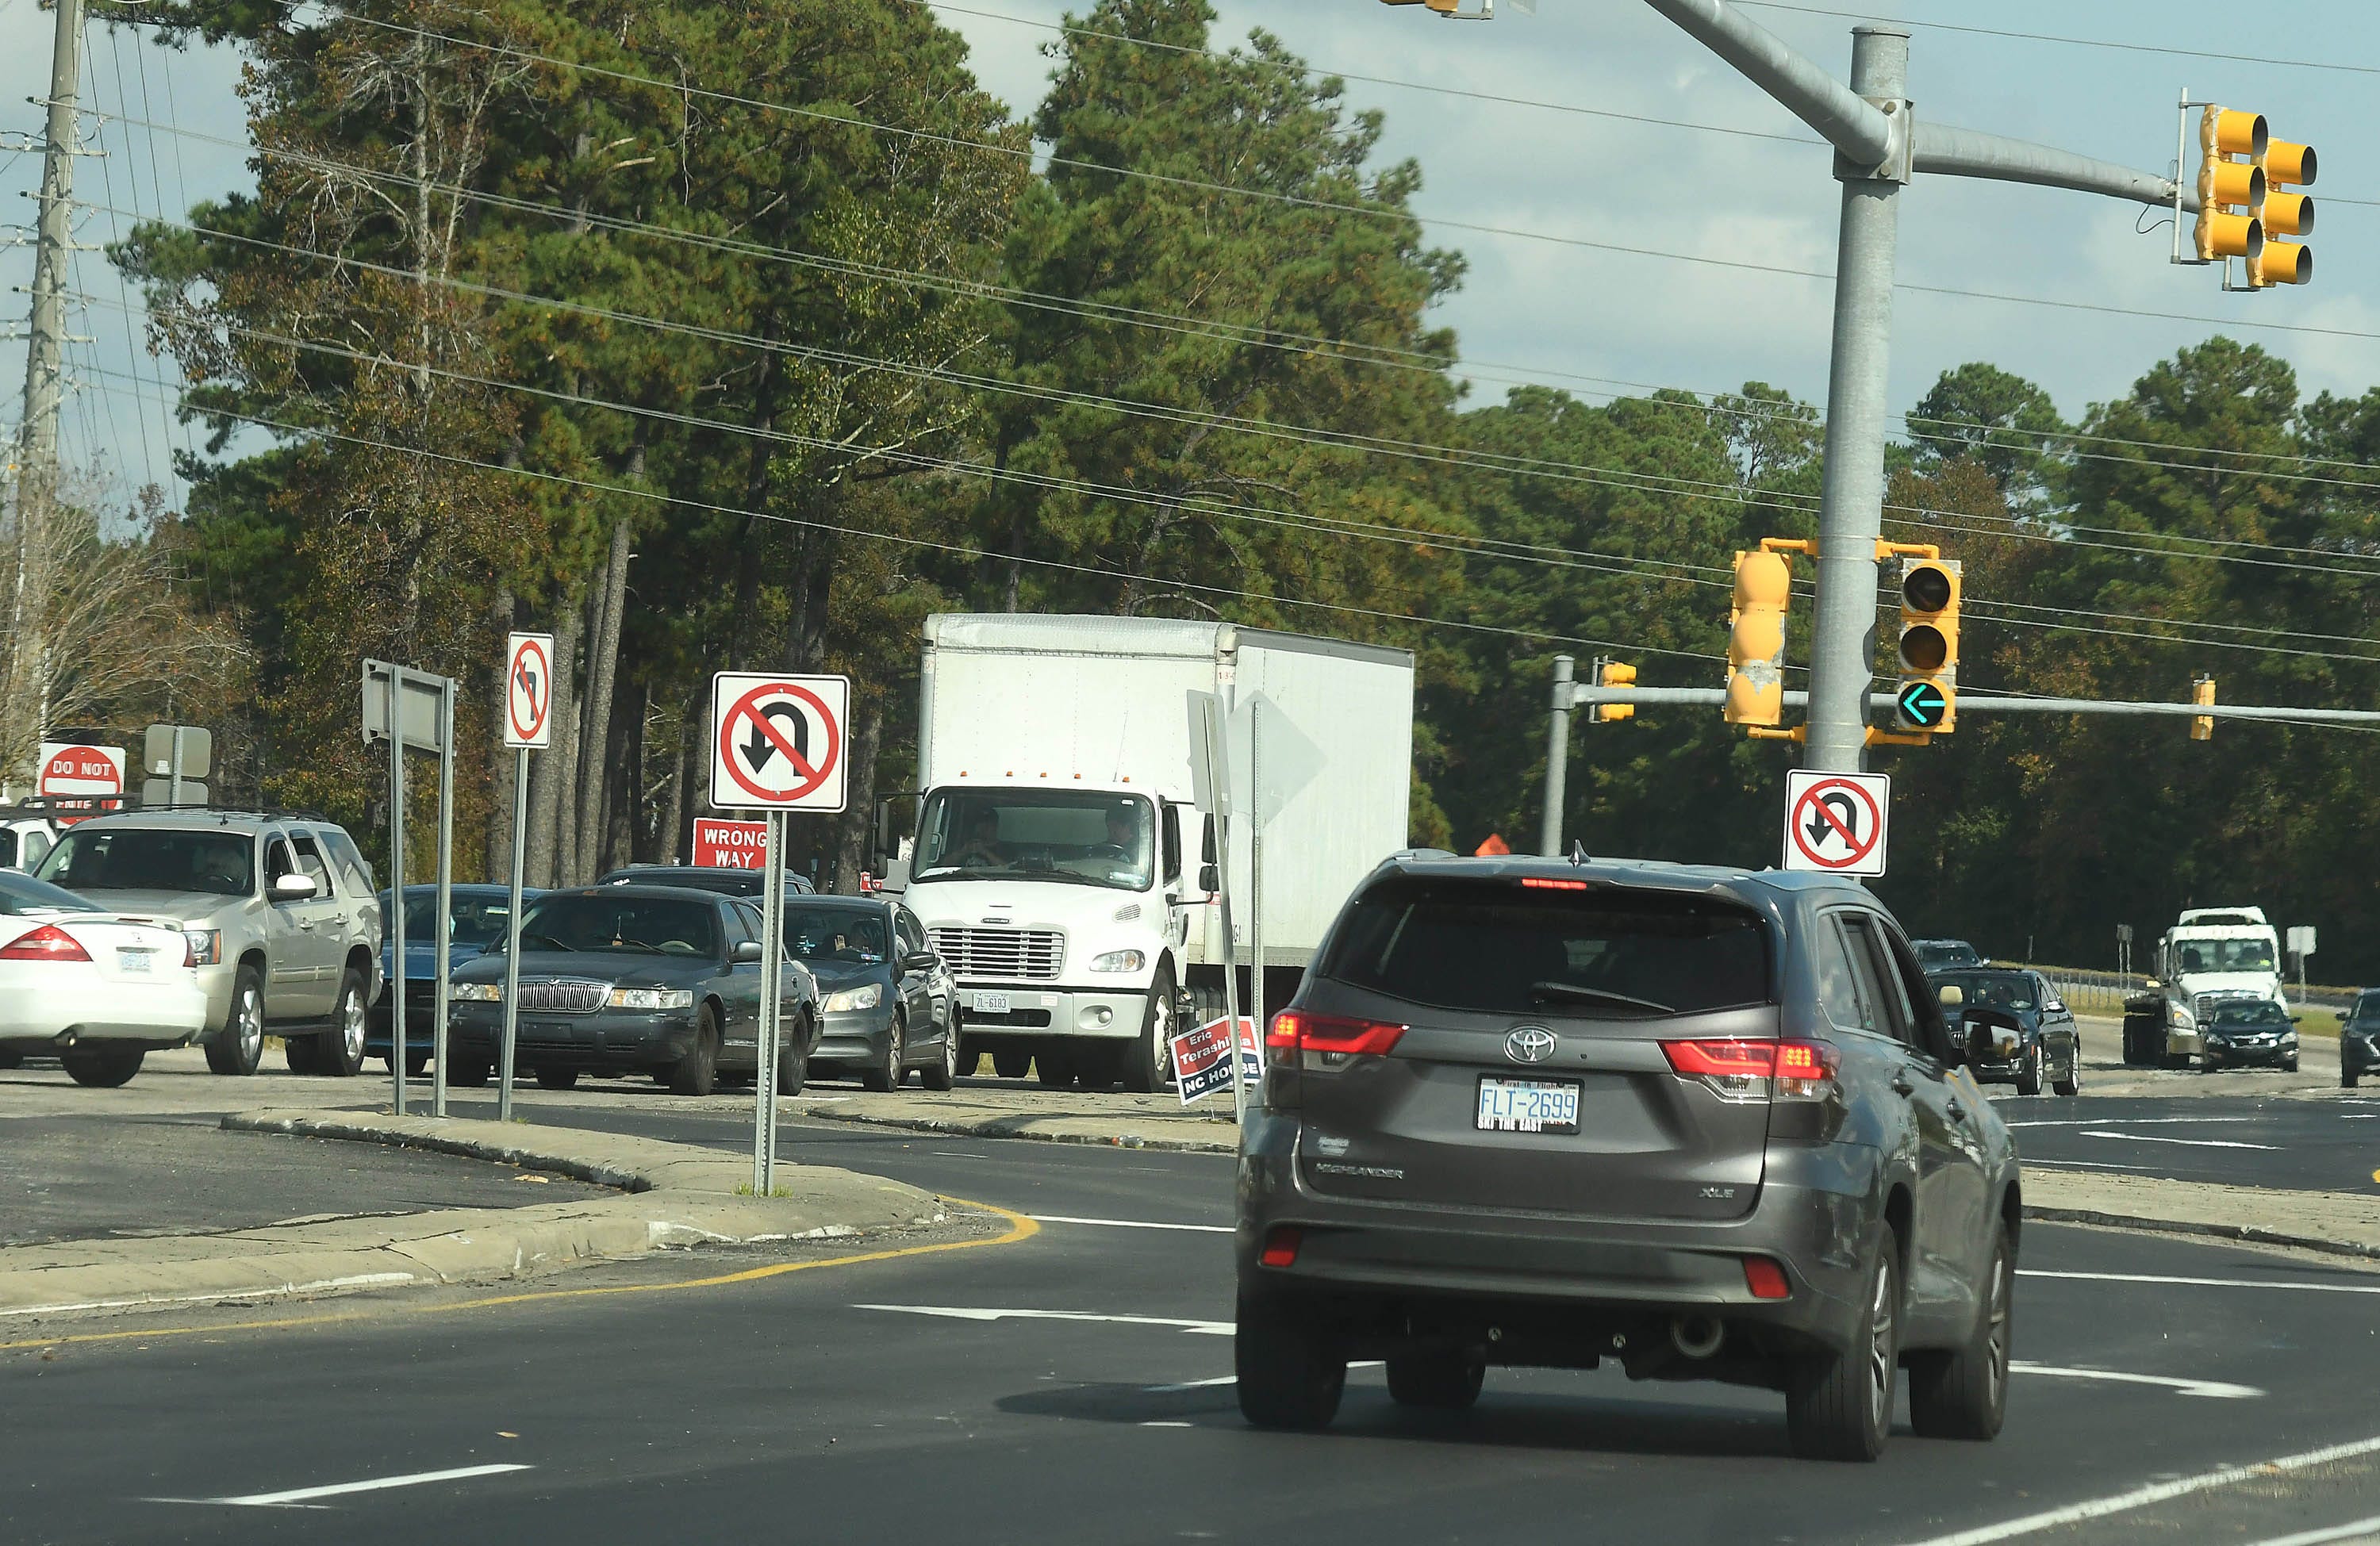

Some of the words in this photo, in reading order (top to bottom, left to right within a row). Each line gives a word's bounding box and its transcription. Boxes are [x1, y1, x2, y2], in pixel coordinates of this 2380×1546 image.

[52, 760, 75, 775] DO
[81, 762, 111, 777] NOT
[704, 828, 767, 848] WRONG
[716, 850, 754, 869] WAY
[977, 997, 1007, 1008] ZL-6183
[1189, 1031, 1213, 1045] Eric
[1180, 1036, 1252, 1065] Terashia
[1184, 1076, 1205, 1094] NC
[1480, 1089, 1576, 1119] FLT-2699
[1477, 1117, 1495, 1130] SKI
[1499, 1117, 1516, 1131] THE
[1518, 1118, 1543, 1133] EAST
